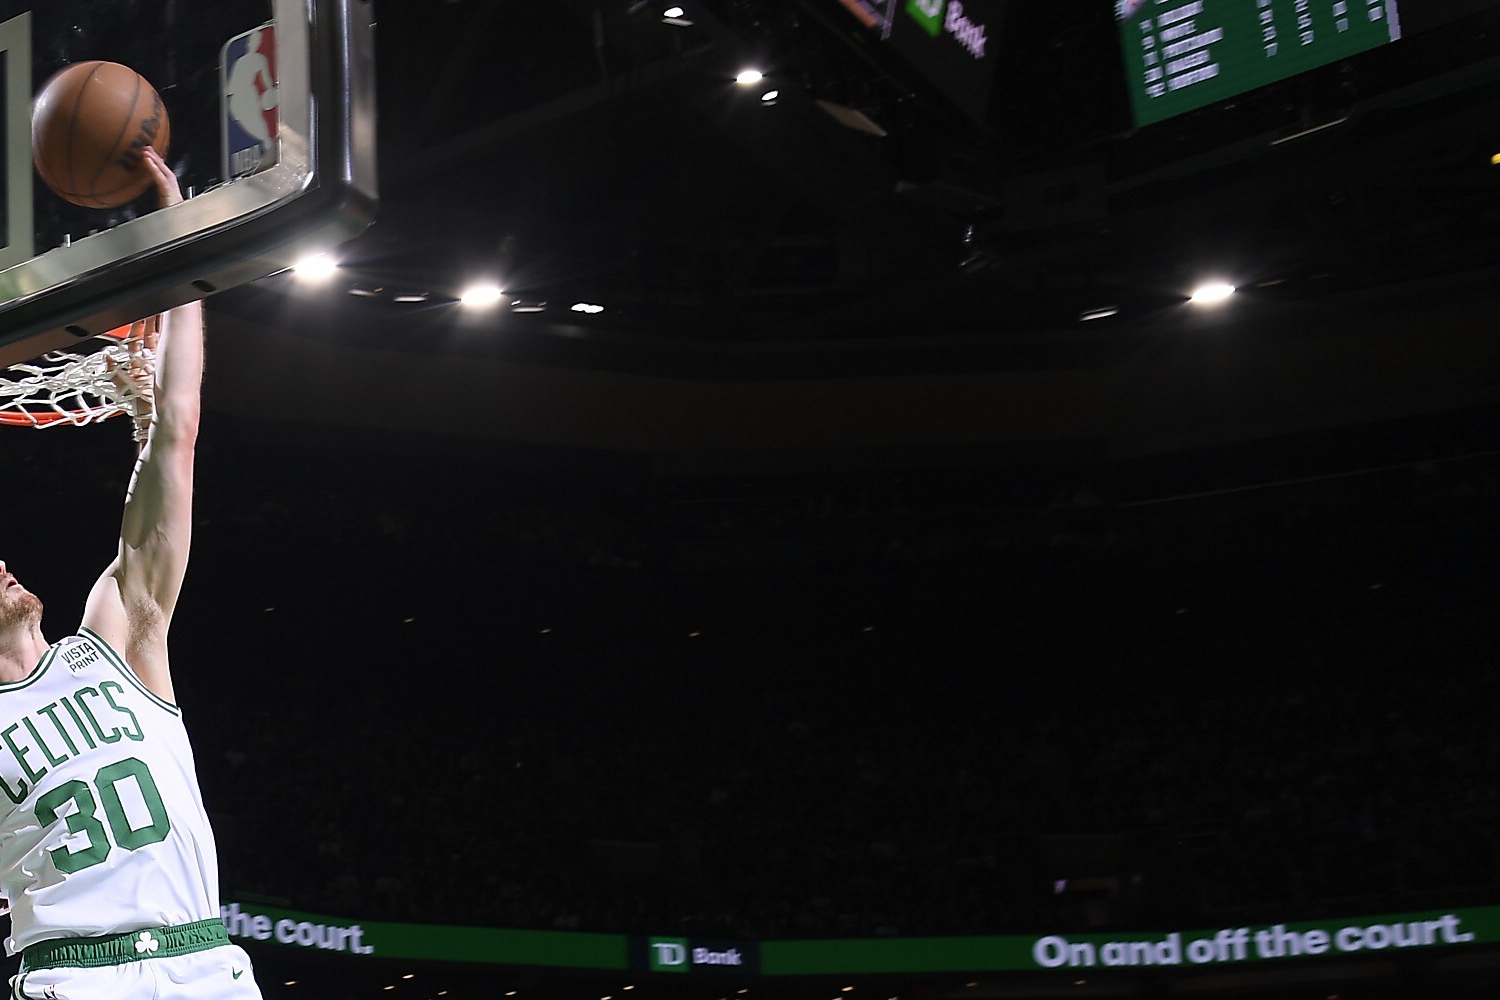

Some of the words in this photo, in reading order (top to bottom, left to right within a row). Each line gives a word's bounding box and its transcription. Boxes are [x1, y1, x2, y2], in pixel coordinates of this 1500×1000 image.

[60, 642, 95, 665] VISTA
[68, 650, 101, 674] PRINT
[34, 756, 172, 875] 30
[221, 902, 273, 941] the
[275, 917, 375, 955] court.
[1032, 935, 1096, 968] On
[1102, 932, 1182, 967] and
[1186, 927, 1249, 965] off
[1254, 923, 1331, 959] the
[1334, 913, 1476, 953] court.
[652, 942, 687, 966] TD
[692, 947, 743, 966] Bank
